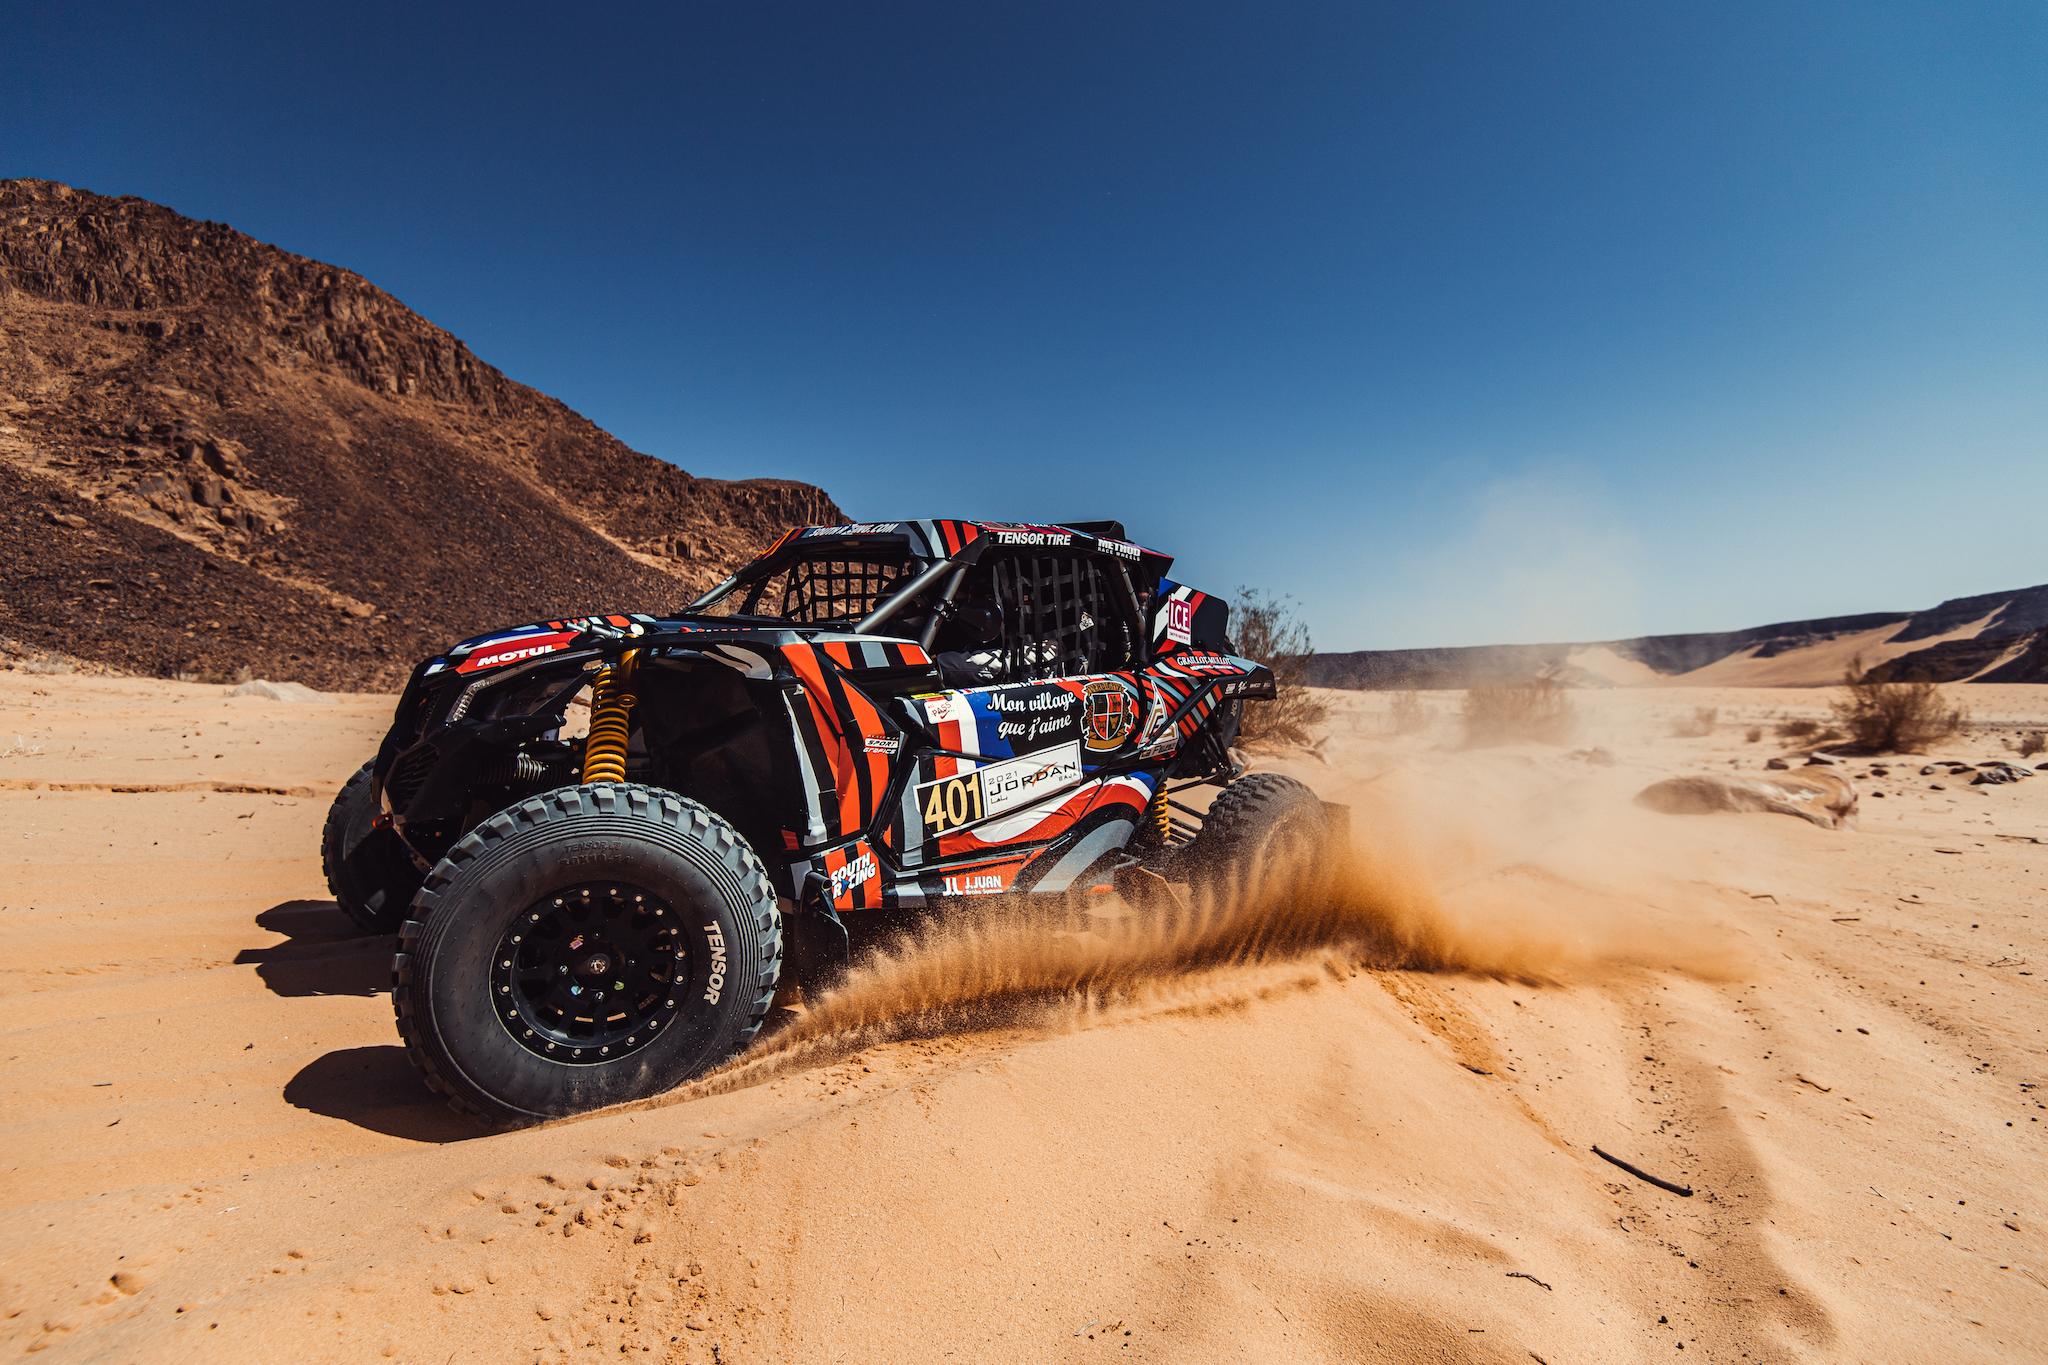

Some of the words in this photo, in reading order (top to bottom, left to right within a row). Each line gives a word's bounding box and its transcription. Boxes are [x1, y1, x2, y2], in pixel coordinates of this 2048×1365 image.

[997, 531, 1045, 546] TENSOR
[1047, 533, 1072, 546] TIRE
[1097, 538, 1141, 557] METHOD
[1097, 547, 1114, 555] RACE
[1116, 551, 1141, 562] WHEELS
[477, 644, 557, 667] MOTUL
[987, 692, 1026, 712] Mon
[1028, 691, 1077, 712] village
[998, 720, 1026, 740] que
[1028, 714, 1073, 741] j'aime
[867, 739, 897, 748] SPORT
[988, 770, 1019, 785] 2021
[989, 761, 1077, 797] JORDAN
[1058, 772, 1078, 782] BAJA
[924, 773, 982, 832] 401
[831, 852, 871, 886] SOUTH
[965, 875, 1002, 889] J.JUAN
[703, 919, 727, 1006] TENSOR
